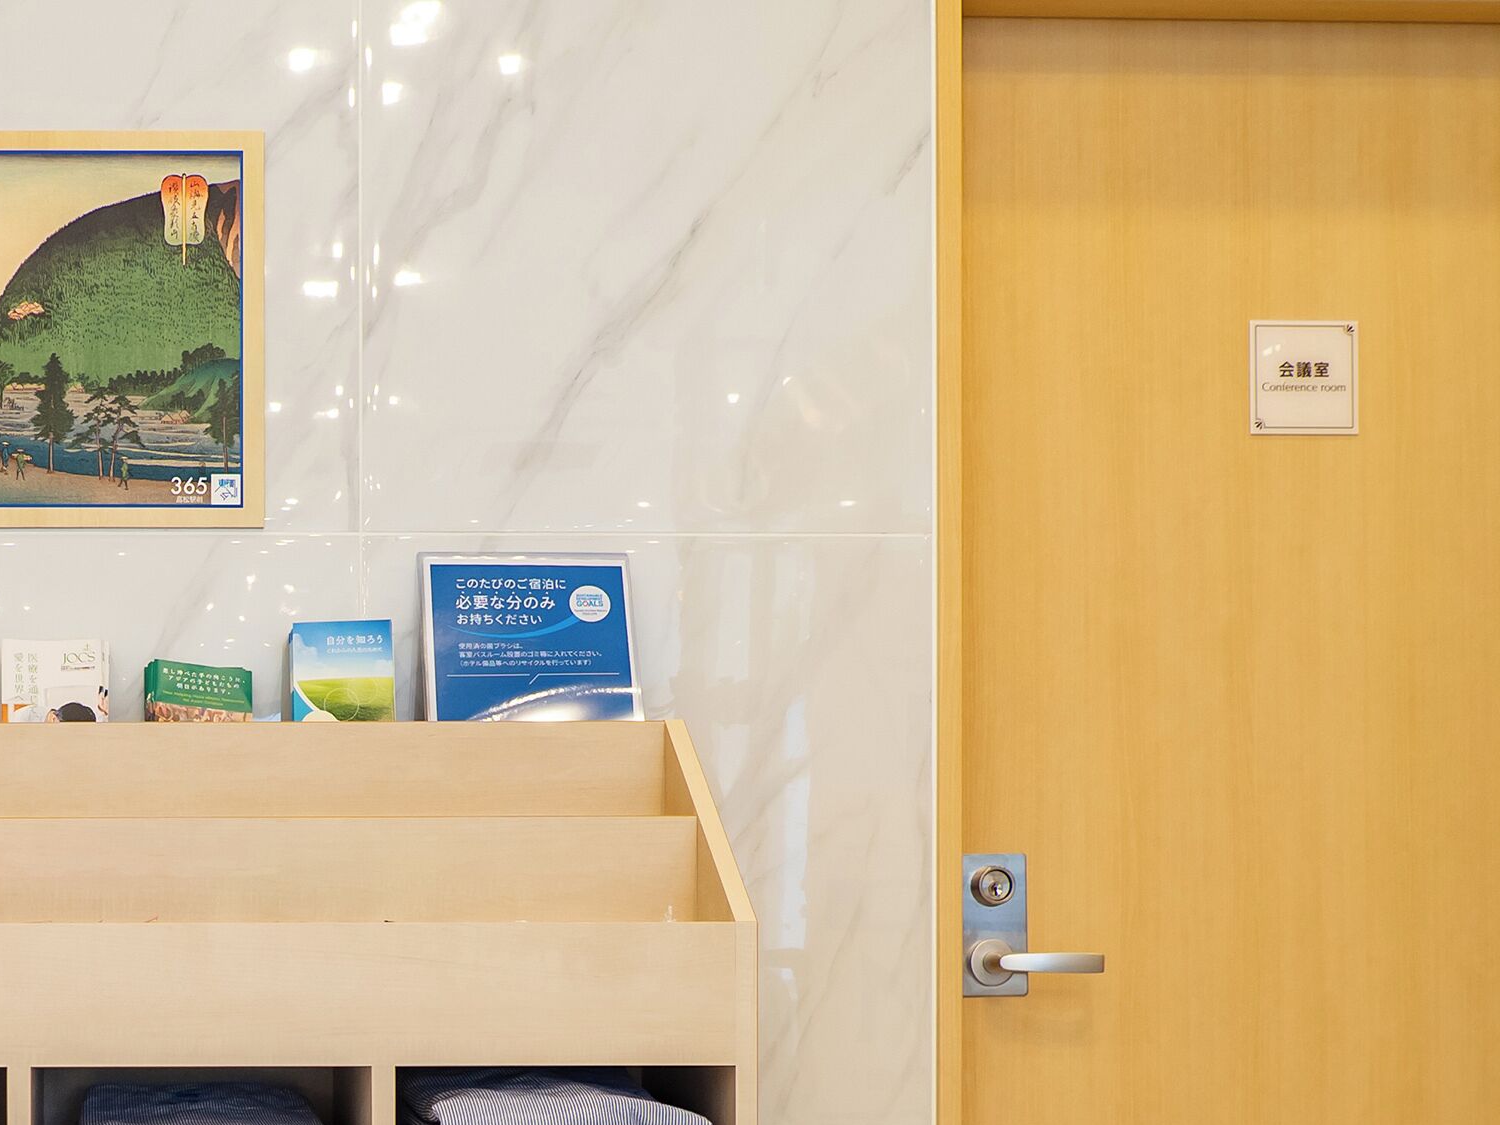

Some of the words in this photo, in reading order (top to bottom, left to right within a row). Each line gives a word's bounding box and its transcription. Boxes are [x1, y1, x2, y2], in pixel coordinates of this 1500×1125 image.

[1279, 361, 1330, 378] 会議室
[1261, 382, 1318, 392] Conference
[1320, 384, 1347, 392] room
[170, 476, 208, 495] 365
[455, 578, 567, 590] このたびのご宿泊に
[455, 595, 556, 610] 必要な分のみ
[456, 614, 543, 625] お持ちください
[326, 634, 384, 646] 自分を知ろう
